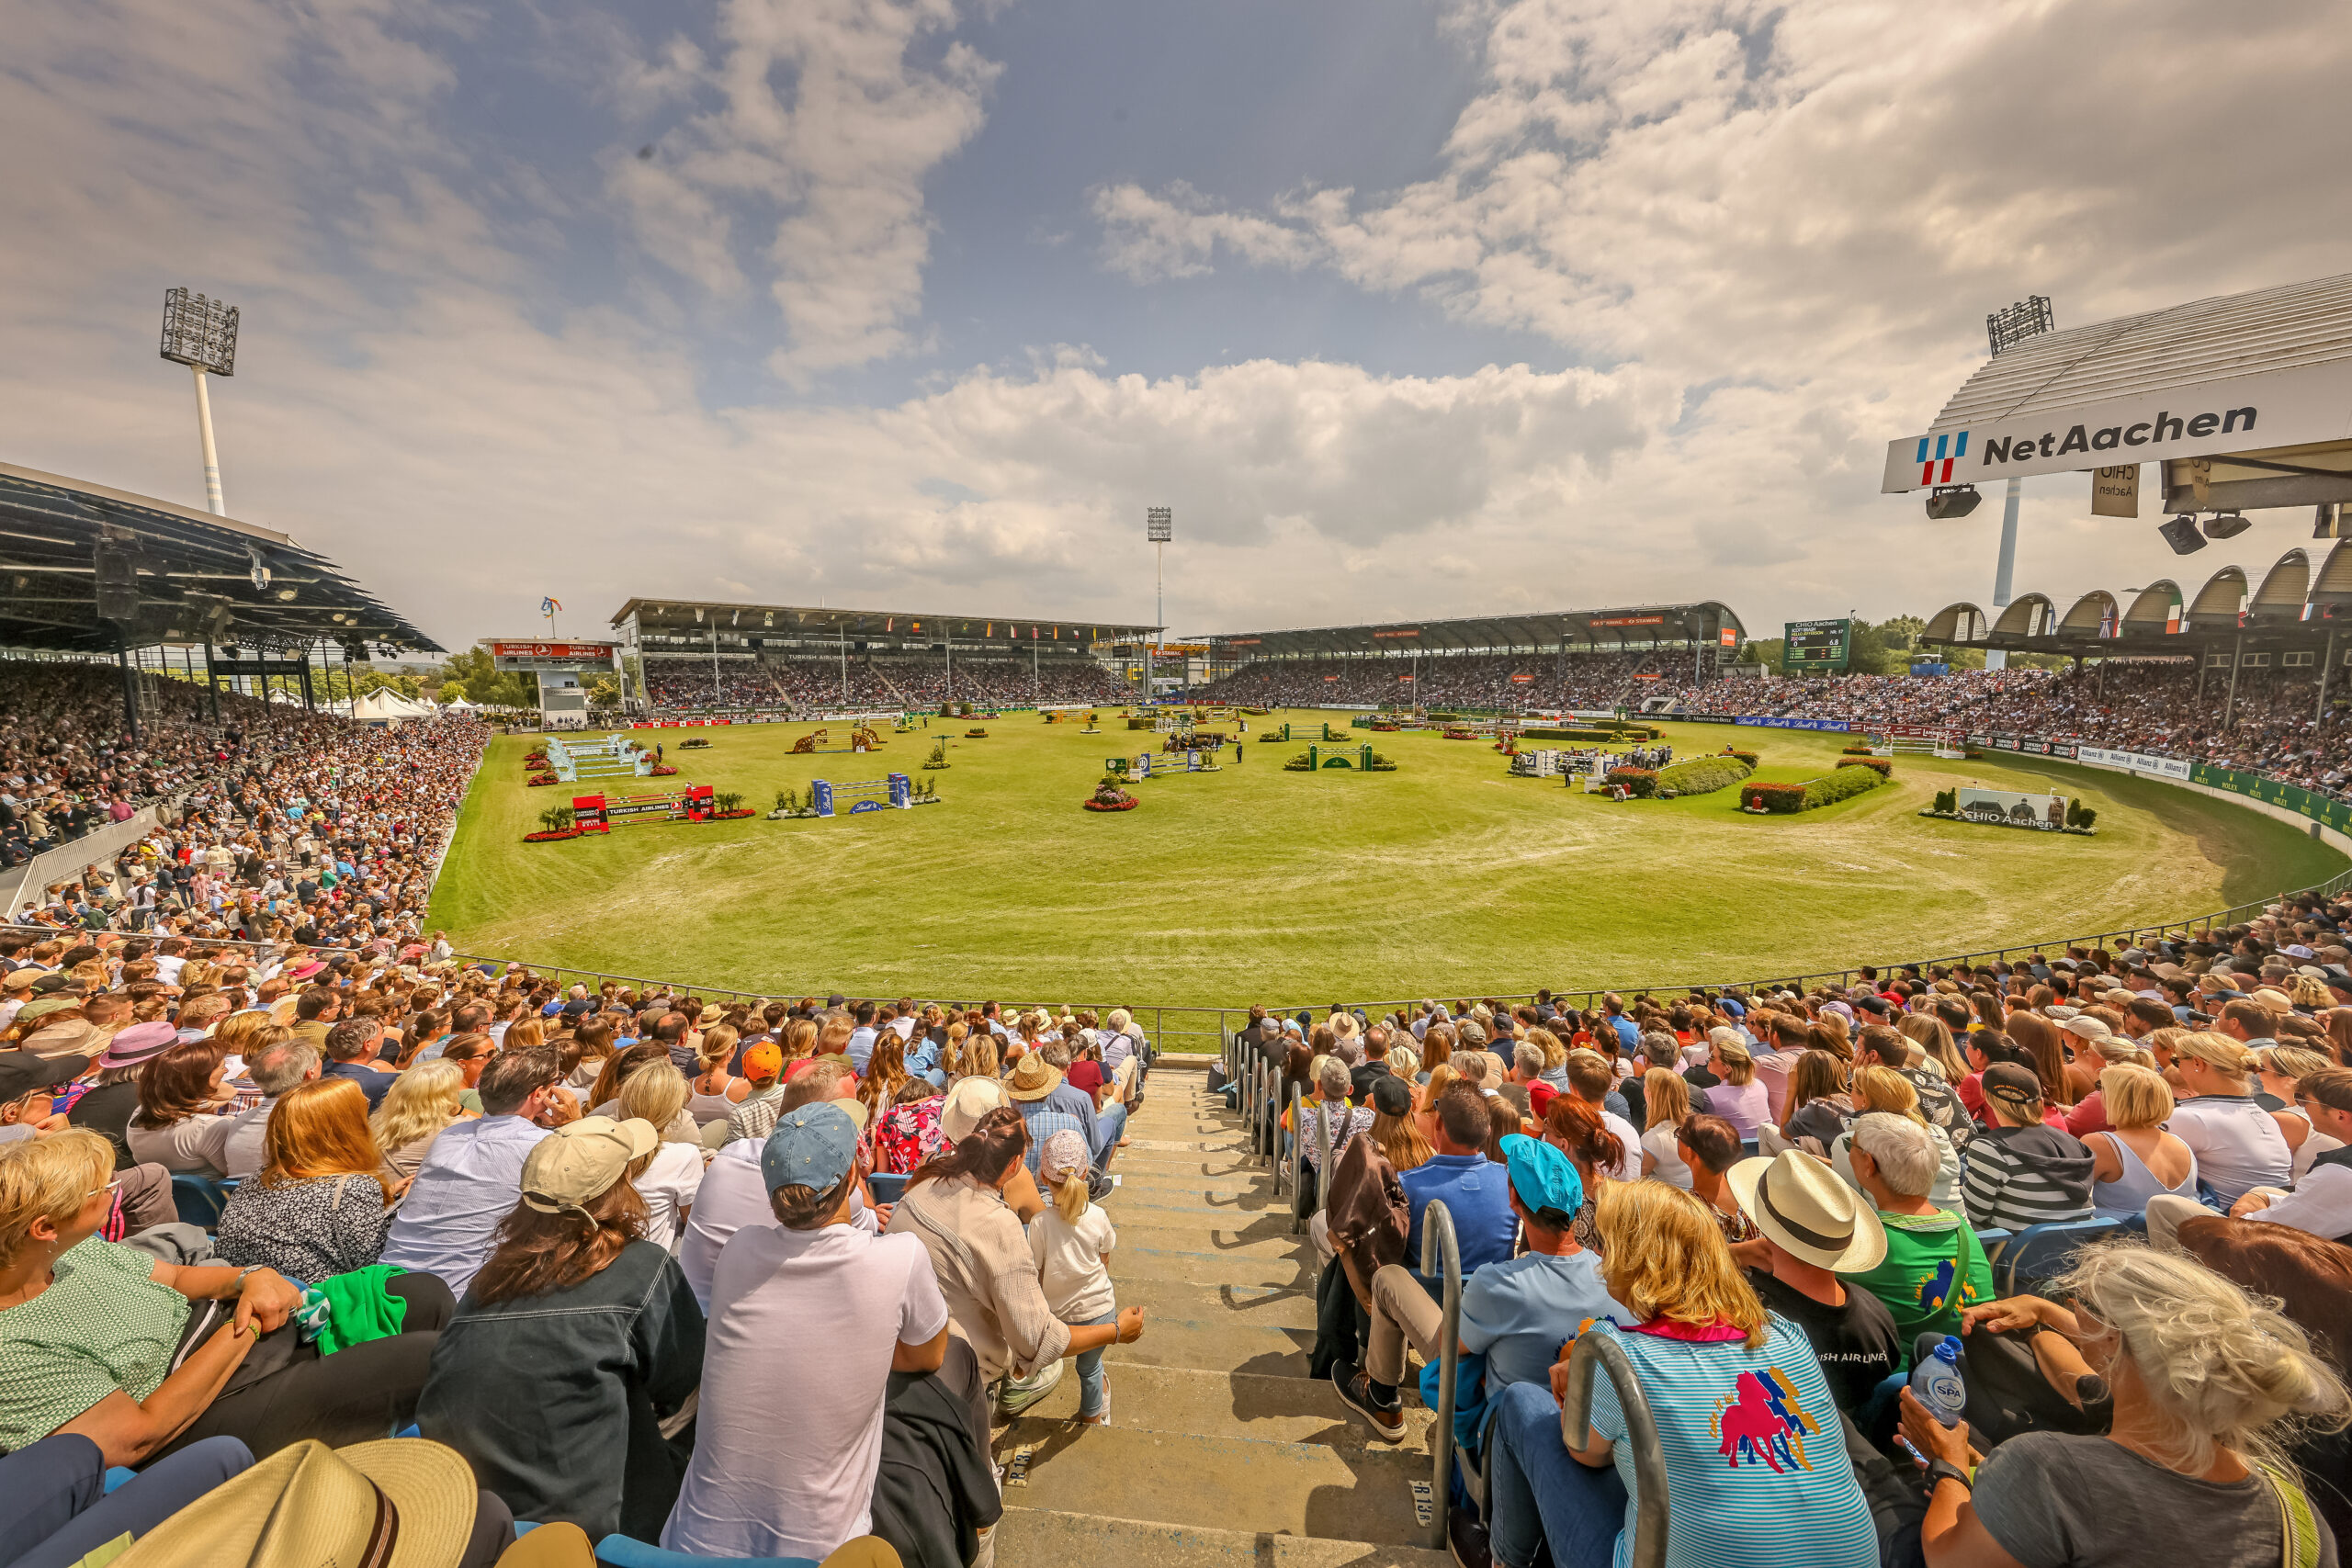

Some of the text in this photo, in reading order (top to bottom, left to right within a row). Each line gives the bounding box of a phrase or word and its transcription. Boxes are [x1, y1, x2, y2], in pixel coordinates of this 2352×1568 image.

[1983, 406, 2257, 466] NetAachen
[1793, 720, 1812, 728] Lindt
[1821, 721, 1842, 730] Lindt
[2110, 753, 2126, 762] Allianz
[2137, 757, 2152, 767] Allianz
[2164, 762, 2182, 772] Allianz
[2195, 776, 2208, 784] ROLEX
[2222, 782, 2237, 791] ROLEX
[2273, 796, 2287, 807] ROLEX
[1965, 811, 2053, 828] CHIO Aachen
[1841, 1350, 1888, 1363] AIRLINES
[1937, 1386, 1961, 1398] SPA
